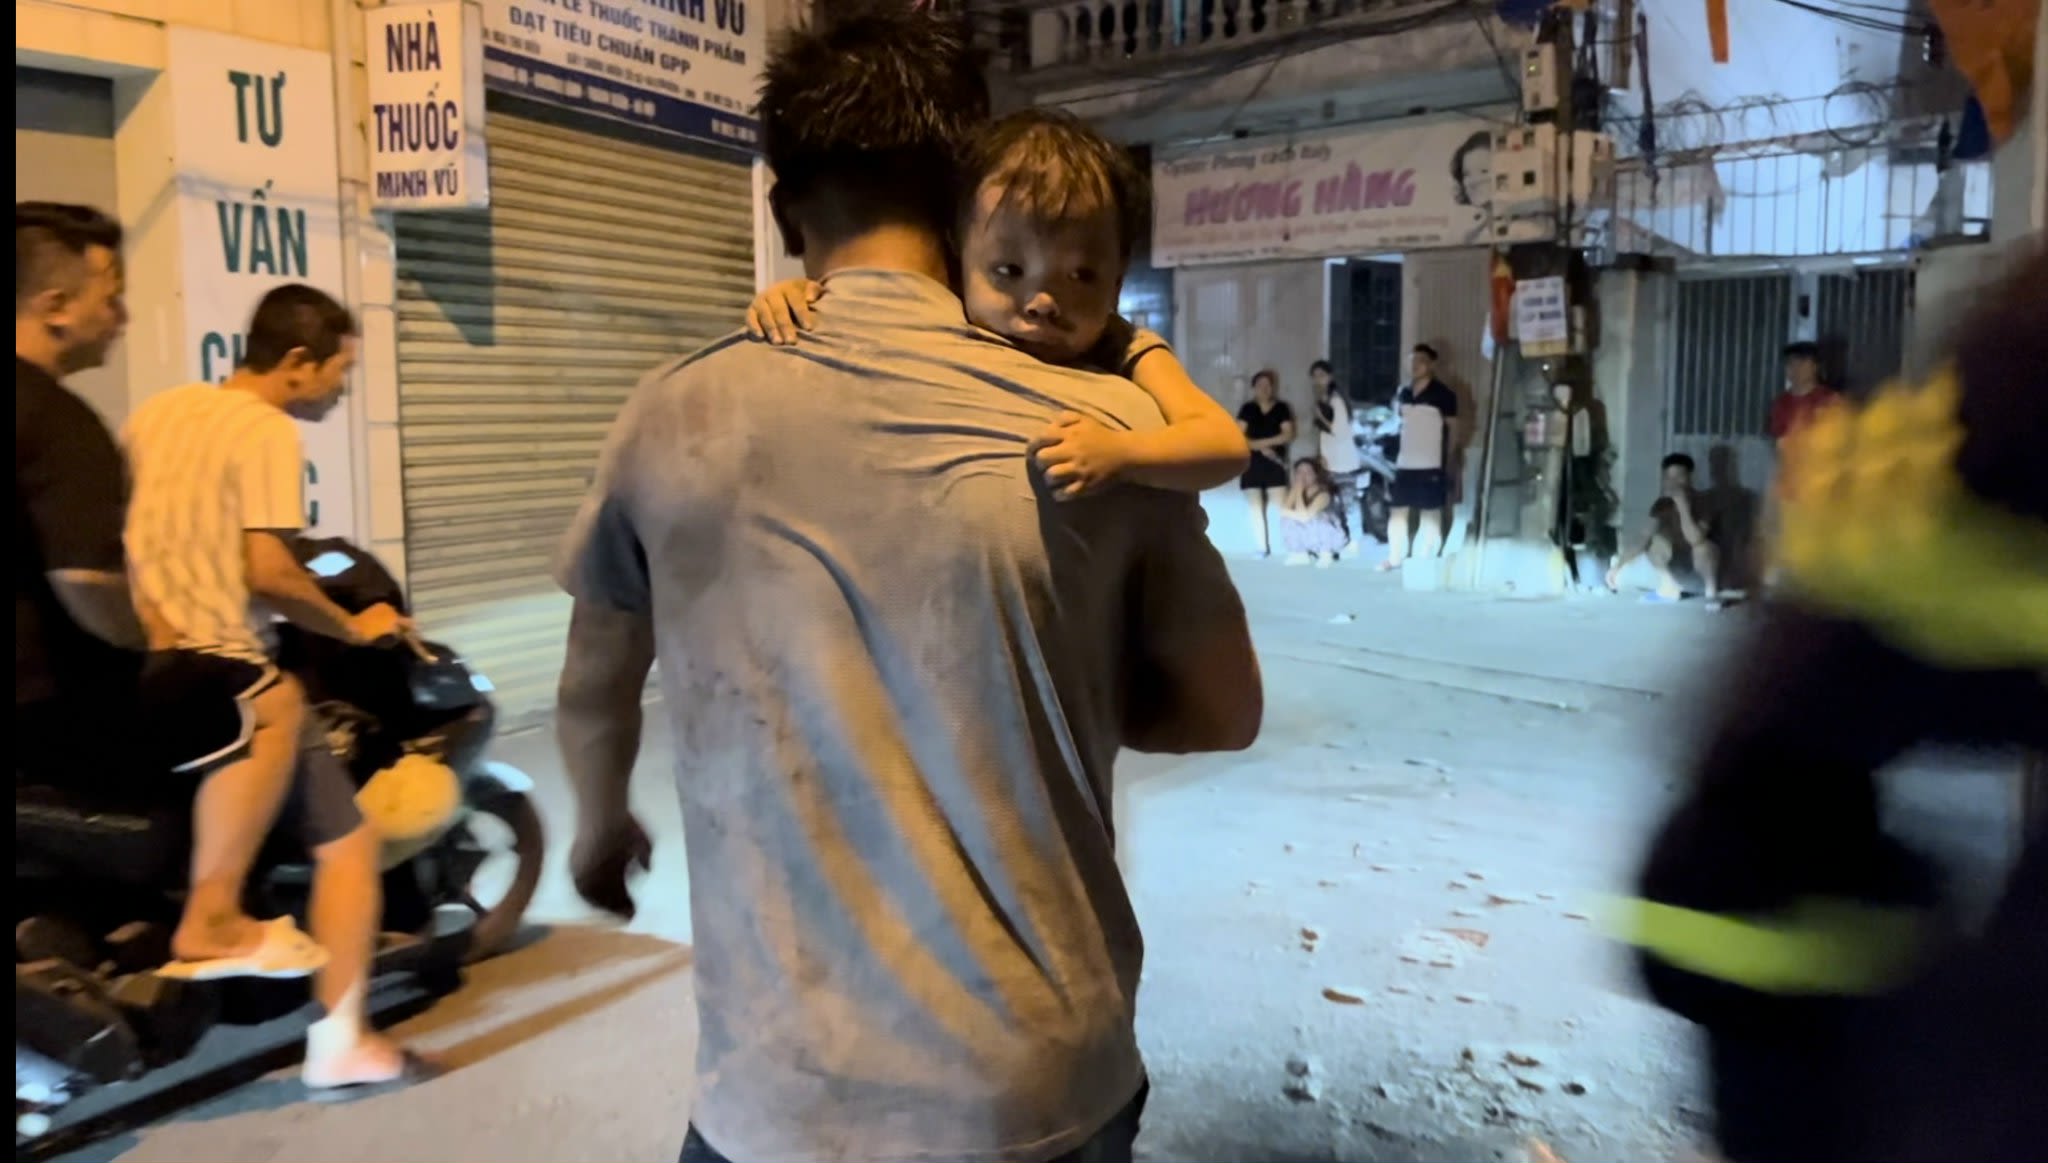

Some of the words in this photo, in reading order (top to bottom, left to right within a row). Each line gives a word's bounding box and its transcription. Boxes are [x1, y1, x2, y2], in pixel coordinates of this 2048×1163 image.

[386, 9, 441, 73] NHÀ
[509, 5, 546, 33] ĐẠT
[553, 19, 592, 46] TIÊU
[659, 52, 691, 75] GPP
[227, 69, 286, 147] TƯ
[373, 81, 458, 153] THUỐC
[376, 169, 428, 198] MINH
[433, 162, 458, 196] VŨ
[216, 178, 308, 278] VẤN
